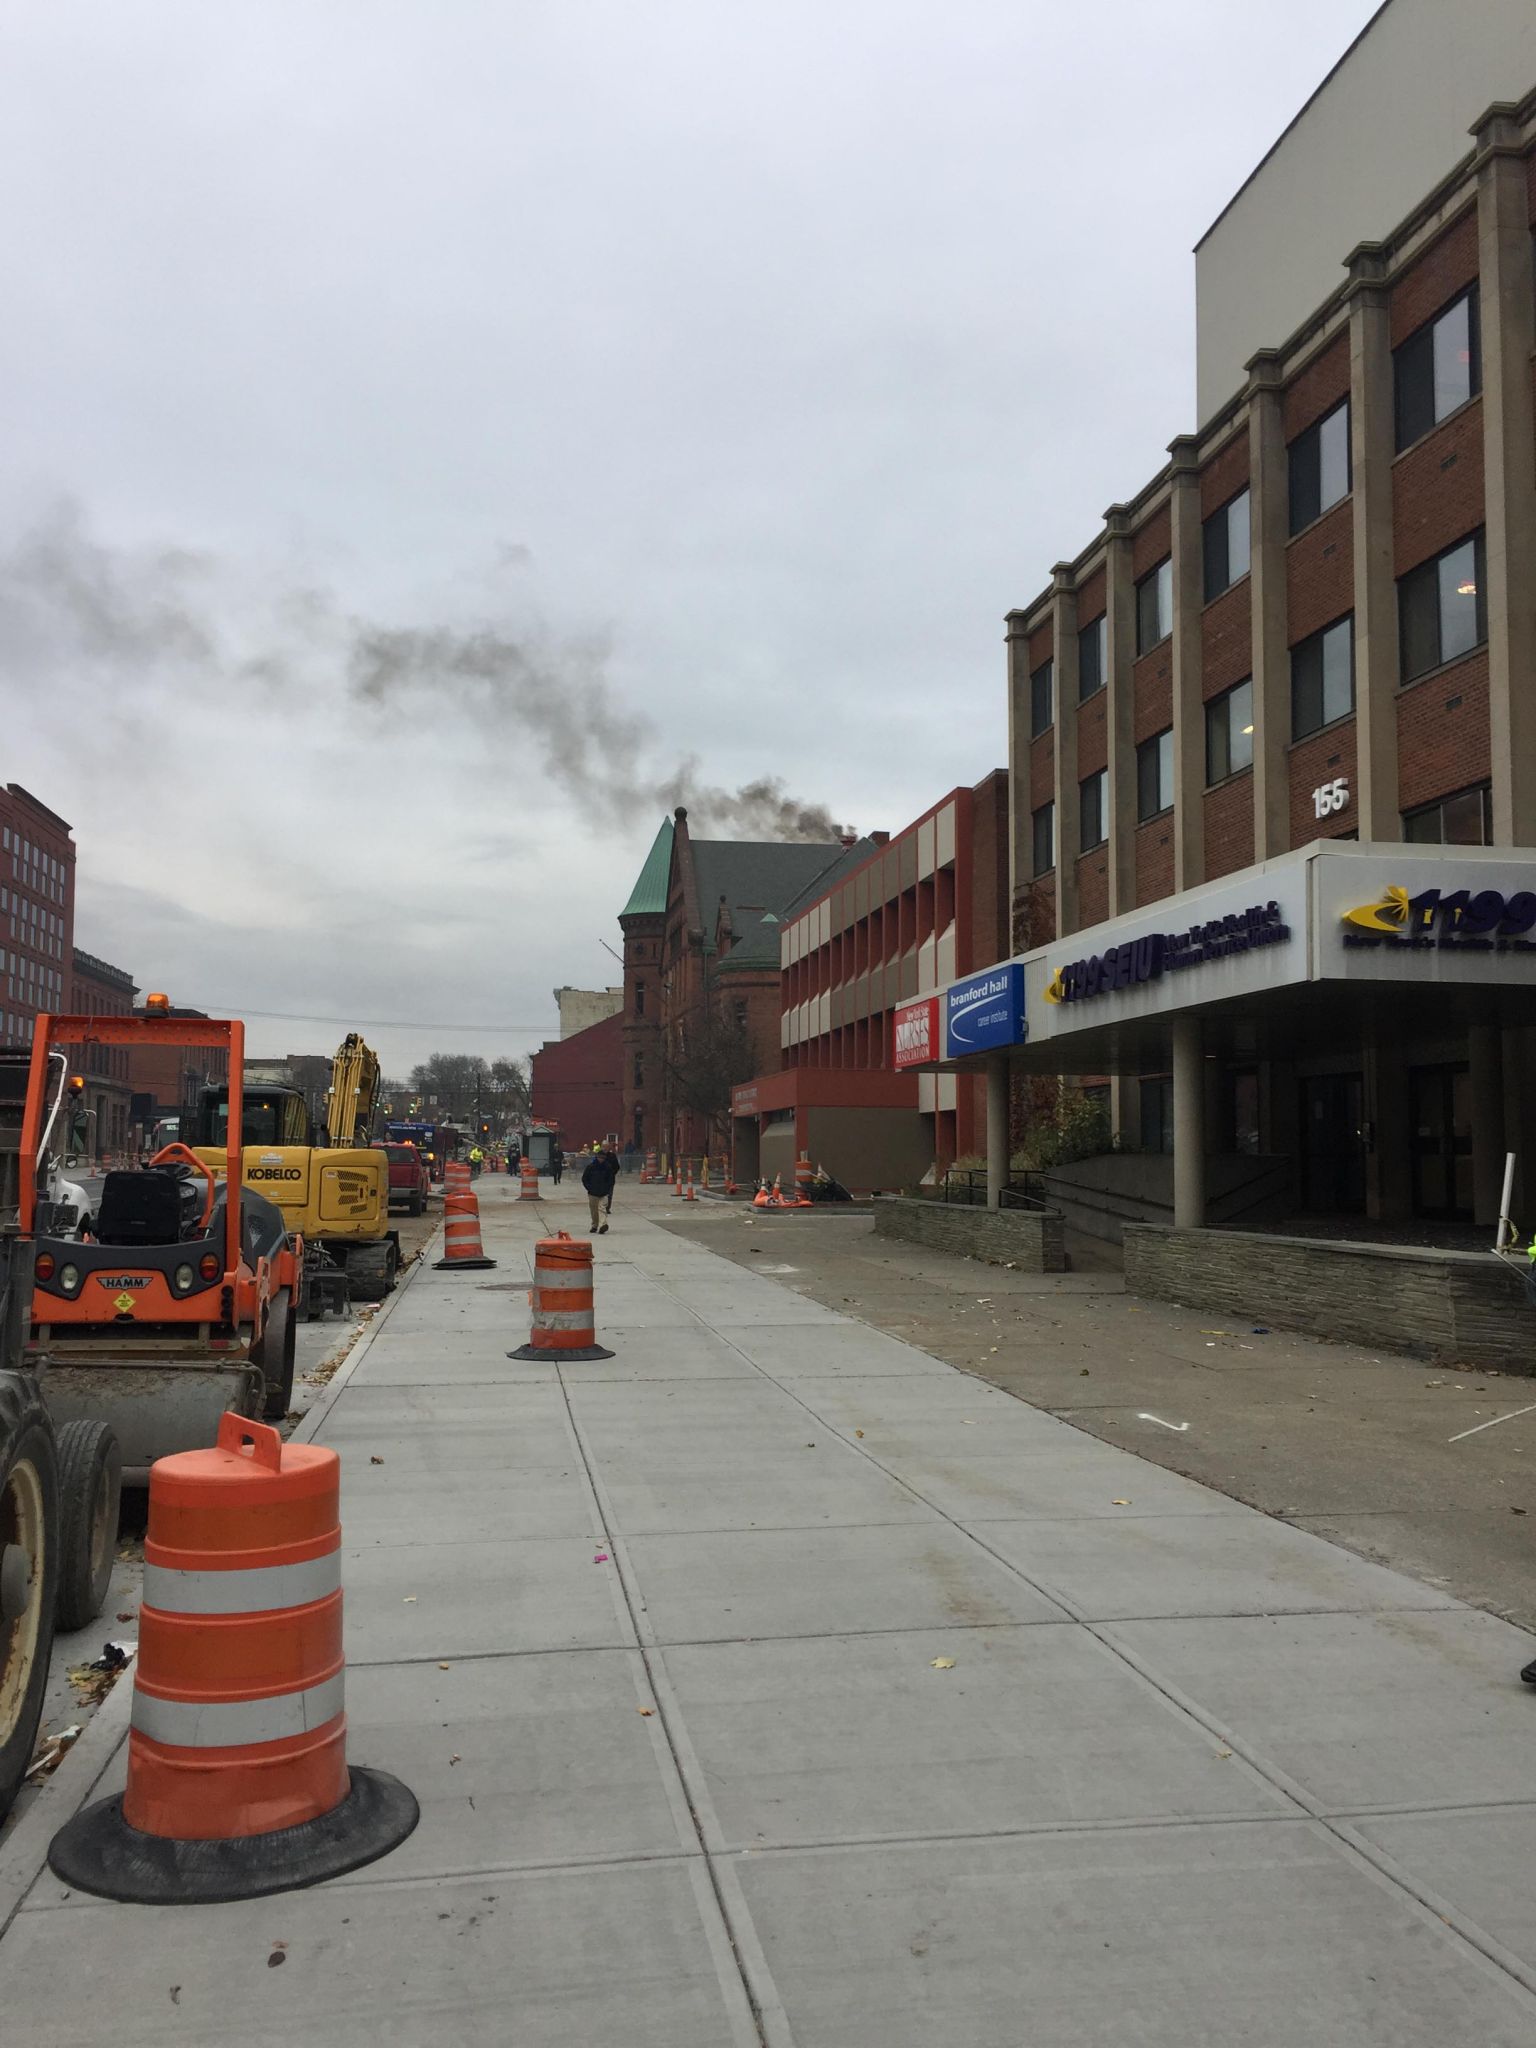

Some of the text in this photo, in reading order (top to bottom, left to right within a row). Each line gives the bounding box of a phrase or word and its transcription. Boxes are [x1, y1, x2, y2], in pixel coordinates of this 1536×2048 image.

[1312, 778, 1349, 819] 155
[1408, 889, 1536, 935] 1199
[950, 976, 1008, 1007] branford hall
[896, 1018, 929, 1052] NURSES
[896, 1045, 929, 1064] ASSOCIATION
[247, 1168, 301, 1180] KOBELCO
[106, 1279, 144, 1287] HAMM
